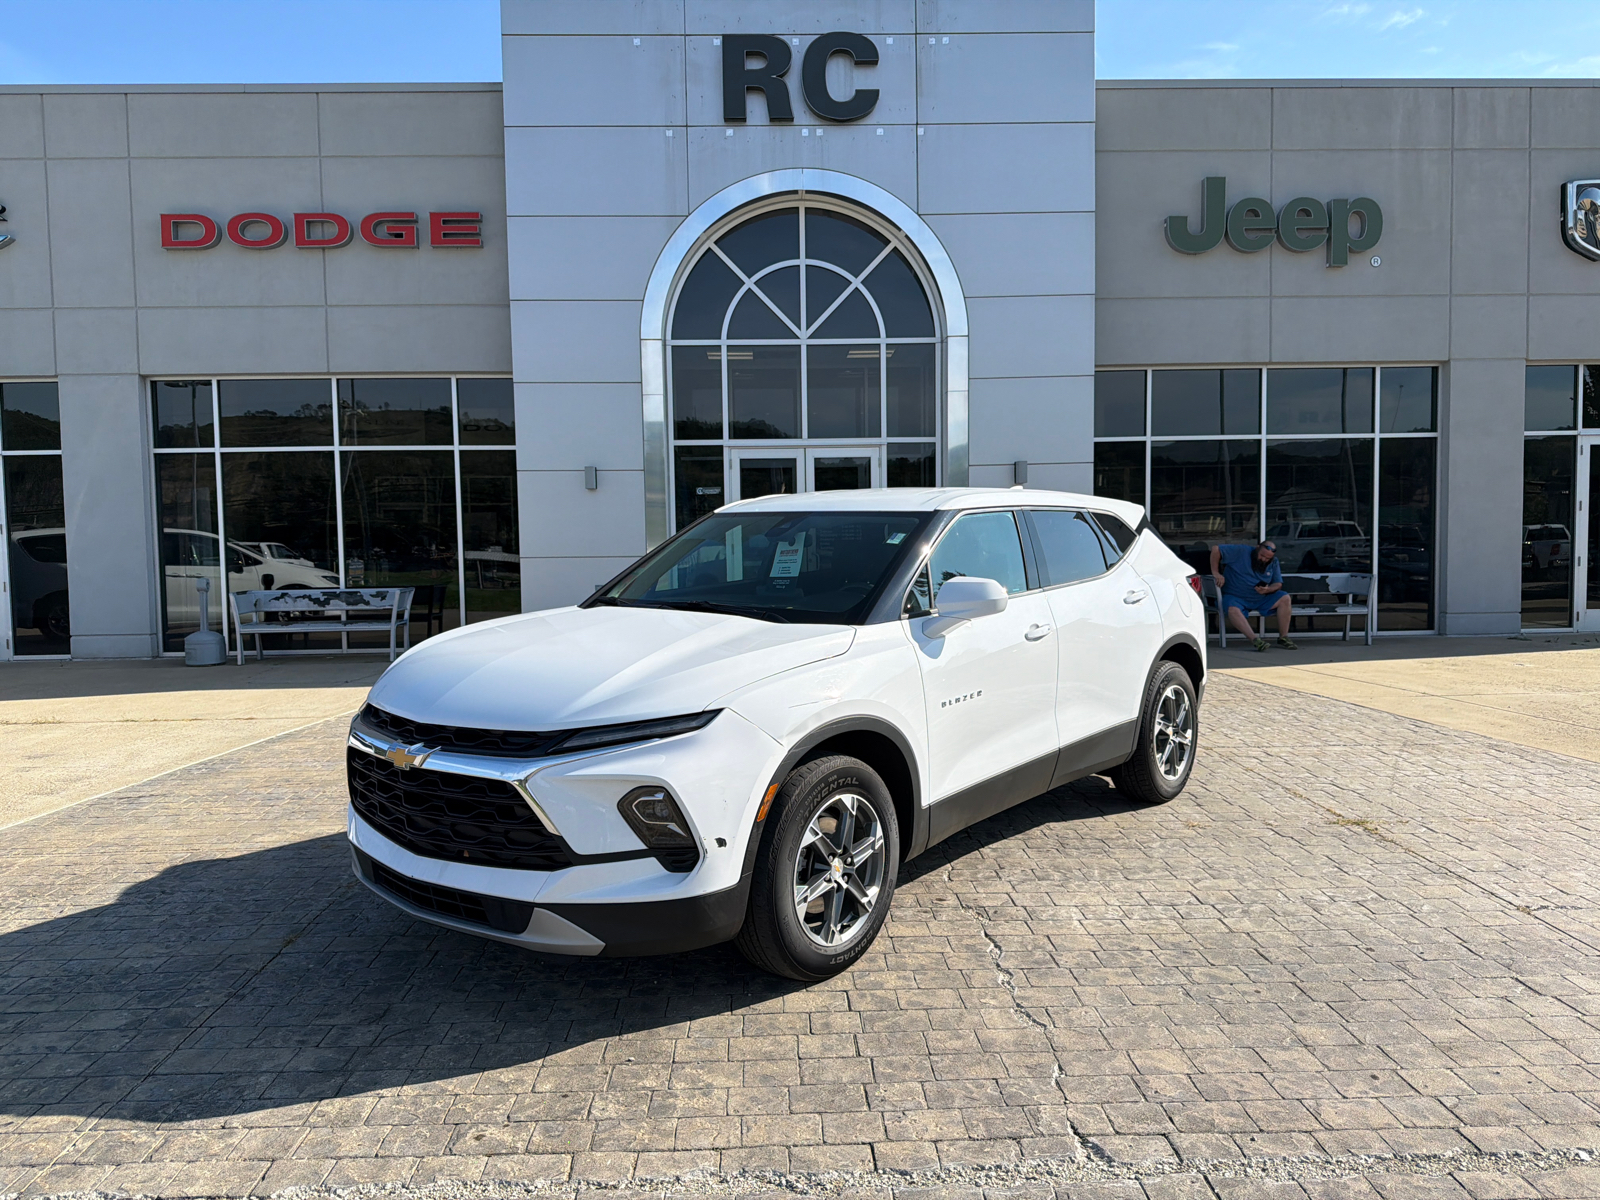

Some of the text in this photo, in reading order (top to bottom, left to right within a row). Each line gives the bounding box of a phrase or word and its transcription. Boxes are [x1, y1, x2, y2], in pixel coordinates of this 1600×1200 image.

[722, 31, 880, 123] RC
[160, 211, 483, 249] DODGE
[1164, 176, 1384, 268] Jeep
[941, 690, 983, 709] BLAZER
